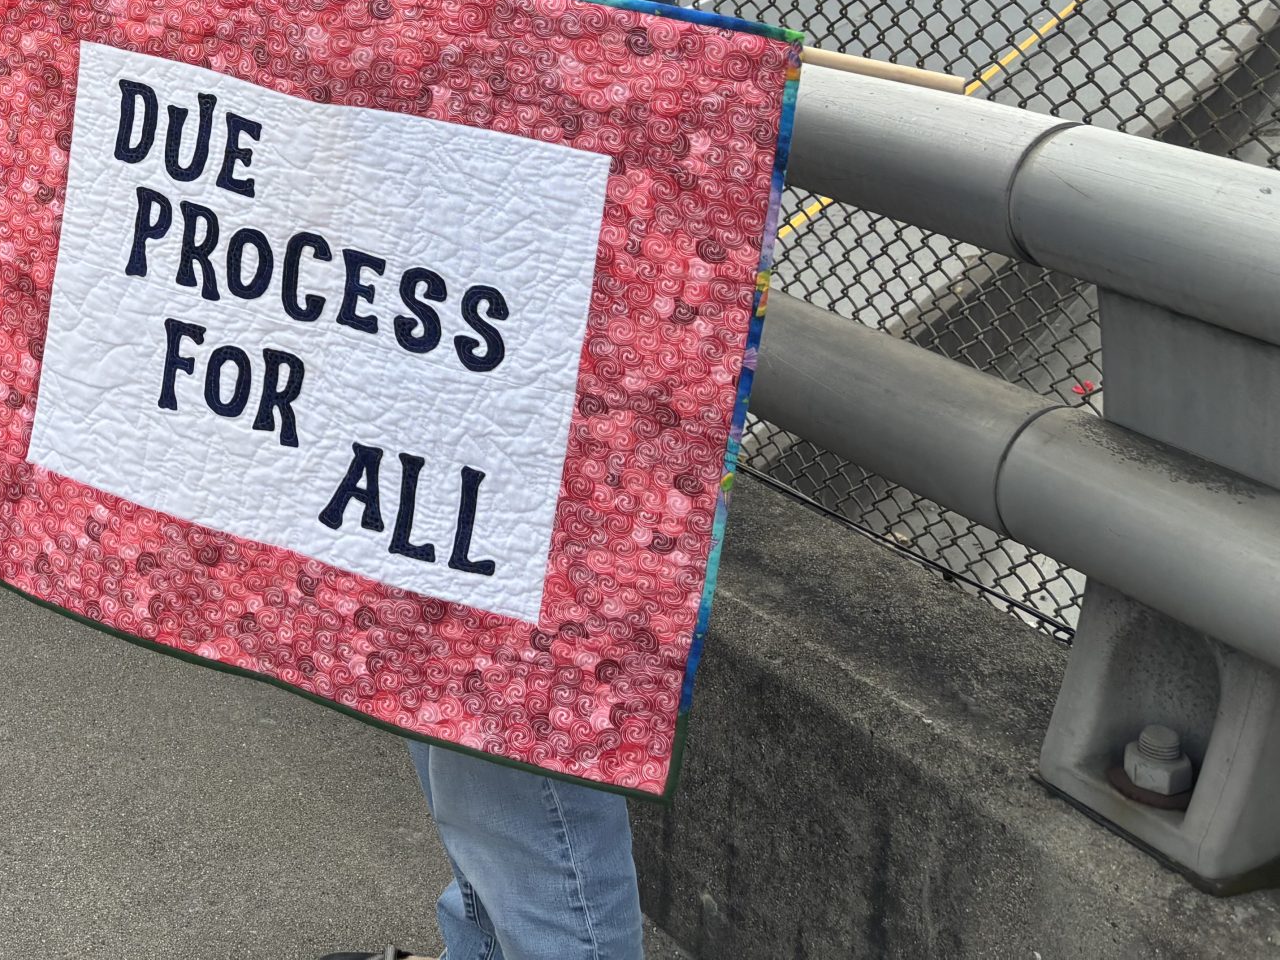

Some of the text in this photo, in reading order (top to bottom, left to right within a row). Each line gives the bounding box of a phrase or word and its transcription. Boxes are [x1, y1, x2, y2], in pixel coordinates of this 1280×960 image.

[113, 78, 262, 198] DUE
[125, 186, 510, 372] PROCESS
[157, 318, 305, 447] FOR
[318, 441, 496, 576] ALL
